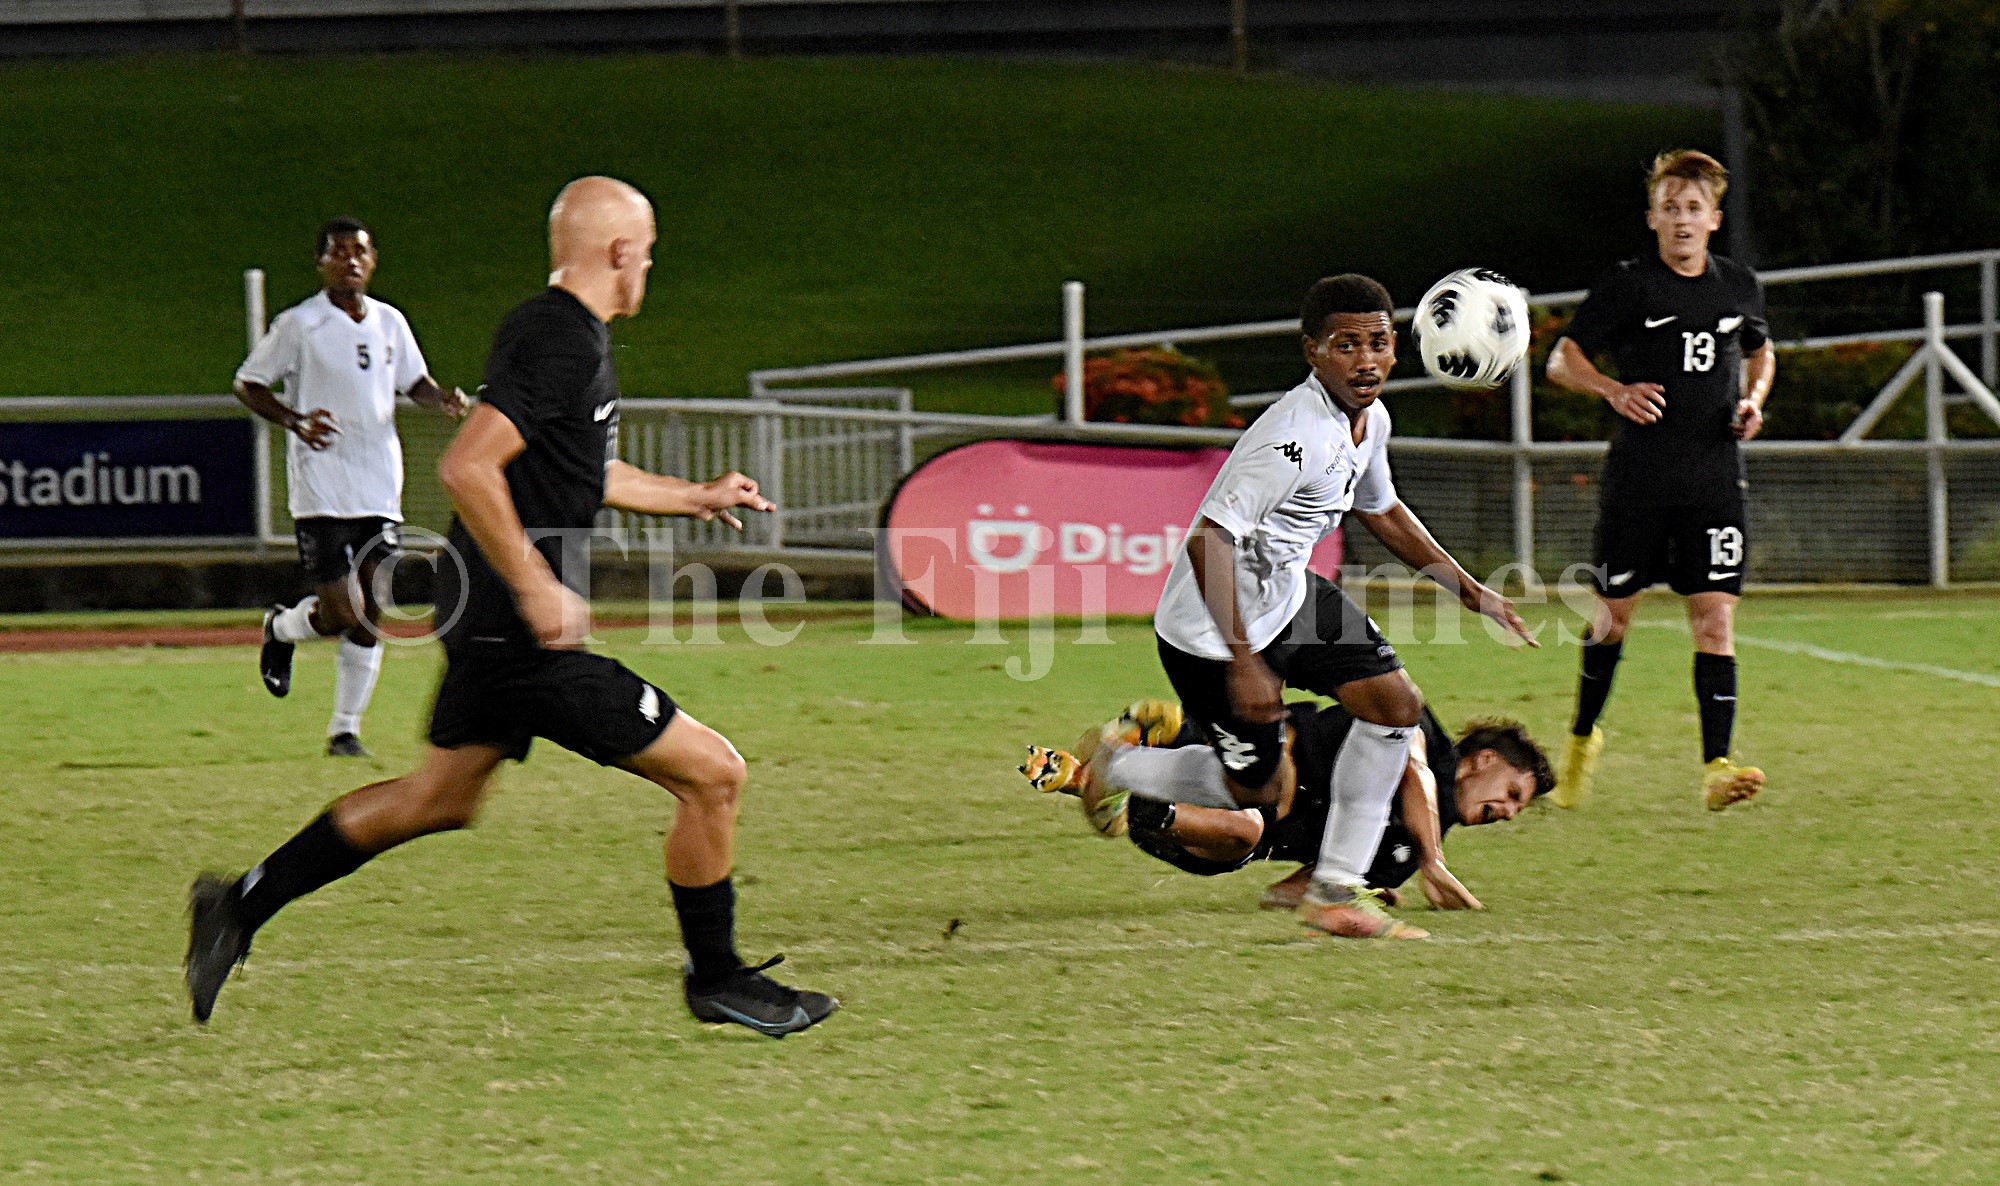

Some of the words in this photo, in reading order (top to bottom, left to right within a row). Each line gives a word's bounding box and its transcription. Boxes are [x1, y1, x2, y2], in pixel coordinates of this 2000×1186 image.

[356, 343, 370, 370] 5
[1681, 331, 1716, 372] 13
[1706, 526, 1743, 566] 13
